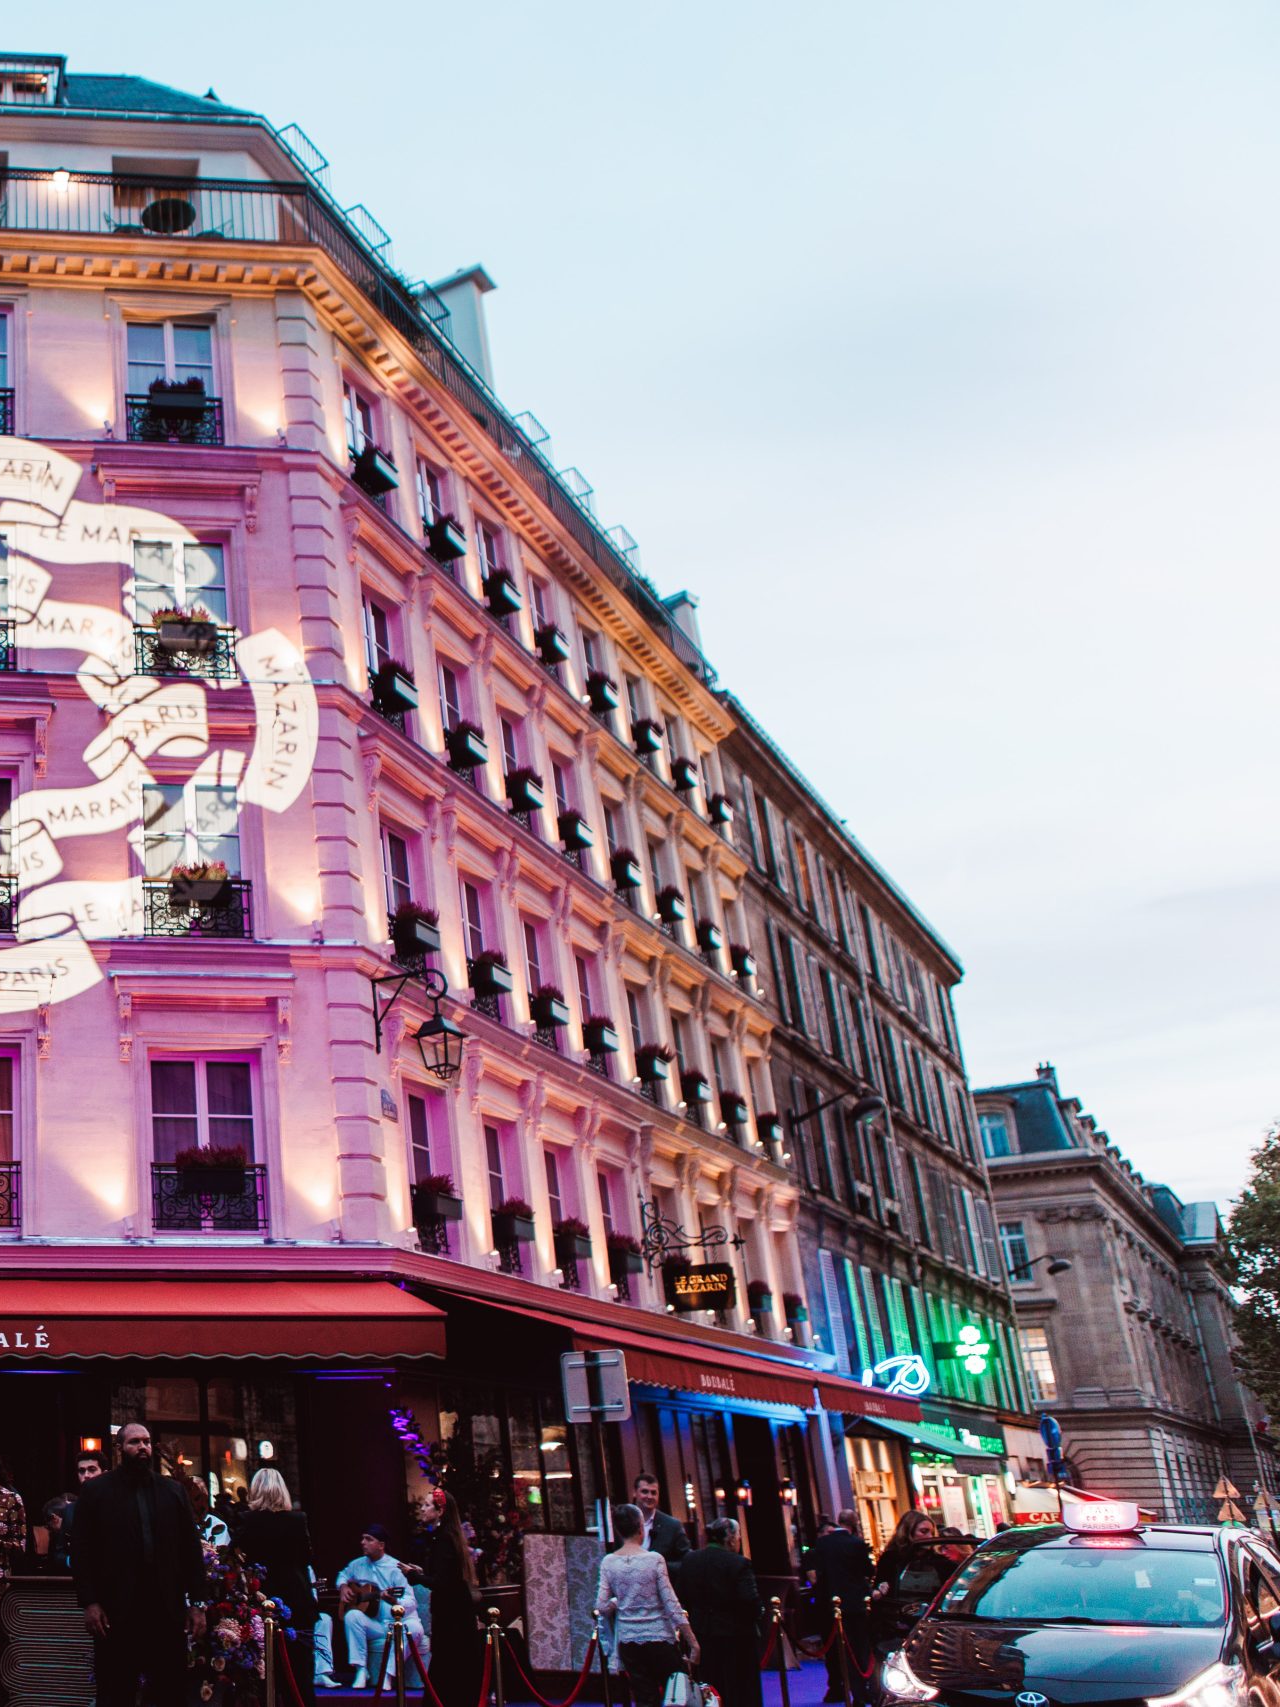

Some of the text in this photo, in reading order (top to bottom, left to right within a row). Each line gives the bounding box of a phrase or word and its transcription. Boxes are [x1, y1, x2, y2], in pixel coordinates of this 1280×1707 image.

[126, 704, 199, 745] PARIS
[258, 654, 298, 791] MAZARIN
[47, 780, 141, 825] MARAIS
[674, 1273, 728, 1286] LE GRAND
[675, 1283, 727, 1295] MAZARIN
[700, 1372, 736, 1392] BOUBALÉ
